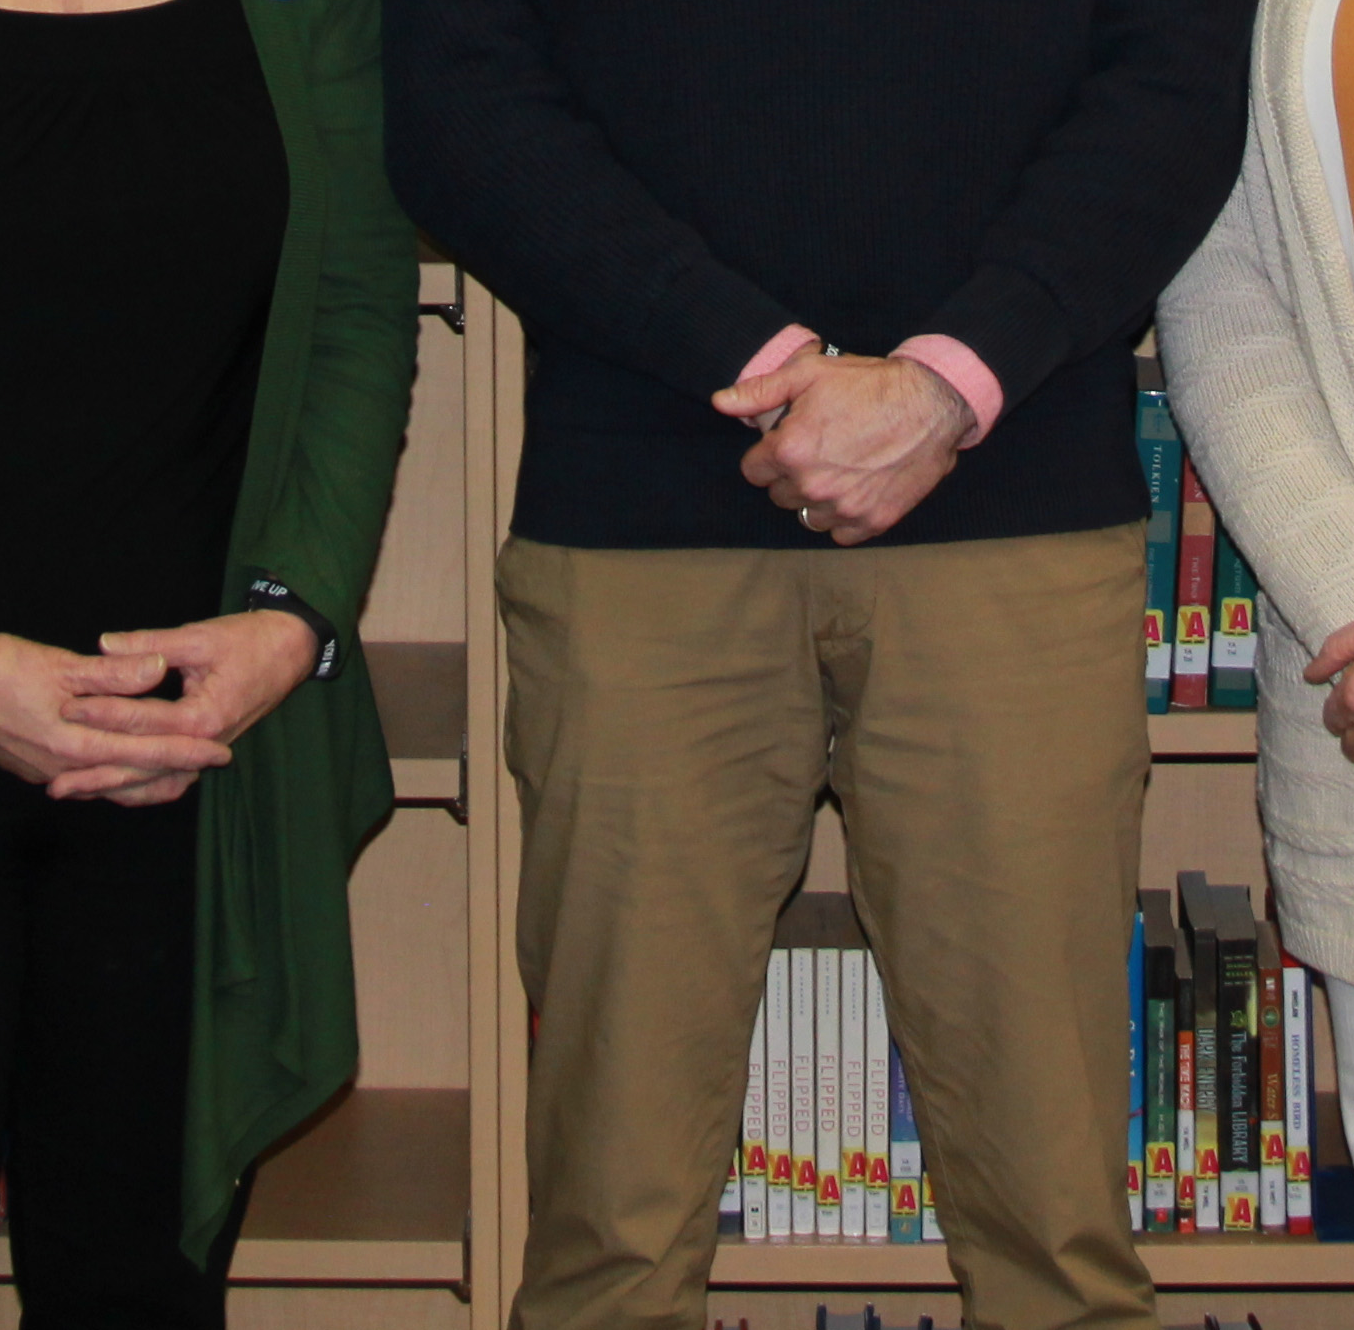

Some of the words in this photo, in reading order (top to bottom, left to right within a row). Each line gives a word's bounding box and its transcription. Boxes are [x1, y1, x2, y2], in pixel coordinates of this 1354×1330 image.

[1151, 445, 1163, 504] TOLKIEN
[268, 583, 288, 597] UP
[1179, 611, 1206, 638] YA
[1224, 603, 1250, 631] YA
[1196, 1028, 1216, 1060] DARK
[1231, 1031, 1247, 1052] The
[1291, 1034, 1302, 1097] HOMELESS
[747, 1062, 763, 1140] FLIPPED
[772, 1059, 787, 1138] FLIPPED
[795, 1055, 810, 1132] FLIPPED
[820, 1055, 835, 1132] FLIPPED
[847, 1060, 862, 1137] FLIPPED
[870, 1059, 885, 1136] FLIPPED
[1196, 1065, 1216, 1114] ENERGY
[1231, 1055, 1248, 1108] Forbidden
[1265, 1073, 1278, 1108] Water
[1231, 1111, 1248, 1163] LIBRARY
[1292, 1102, 1302, 1130] BIRD
